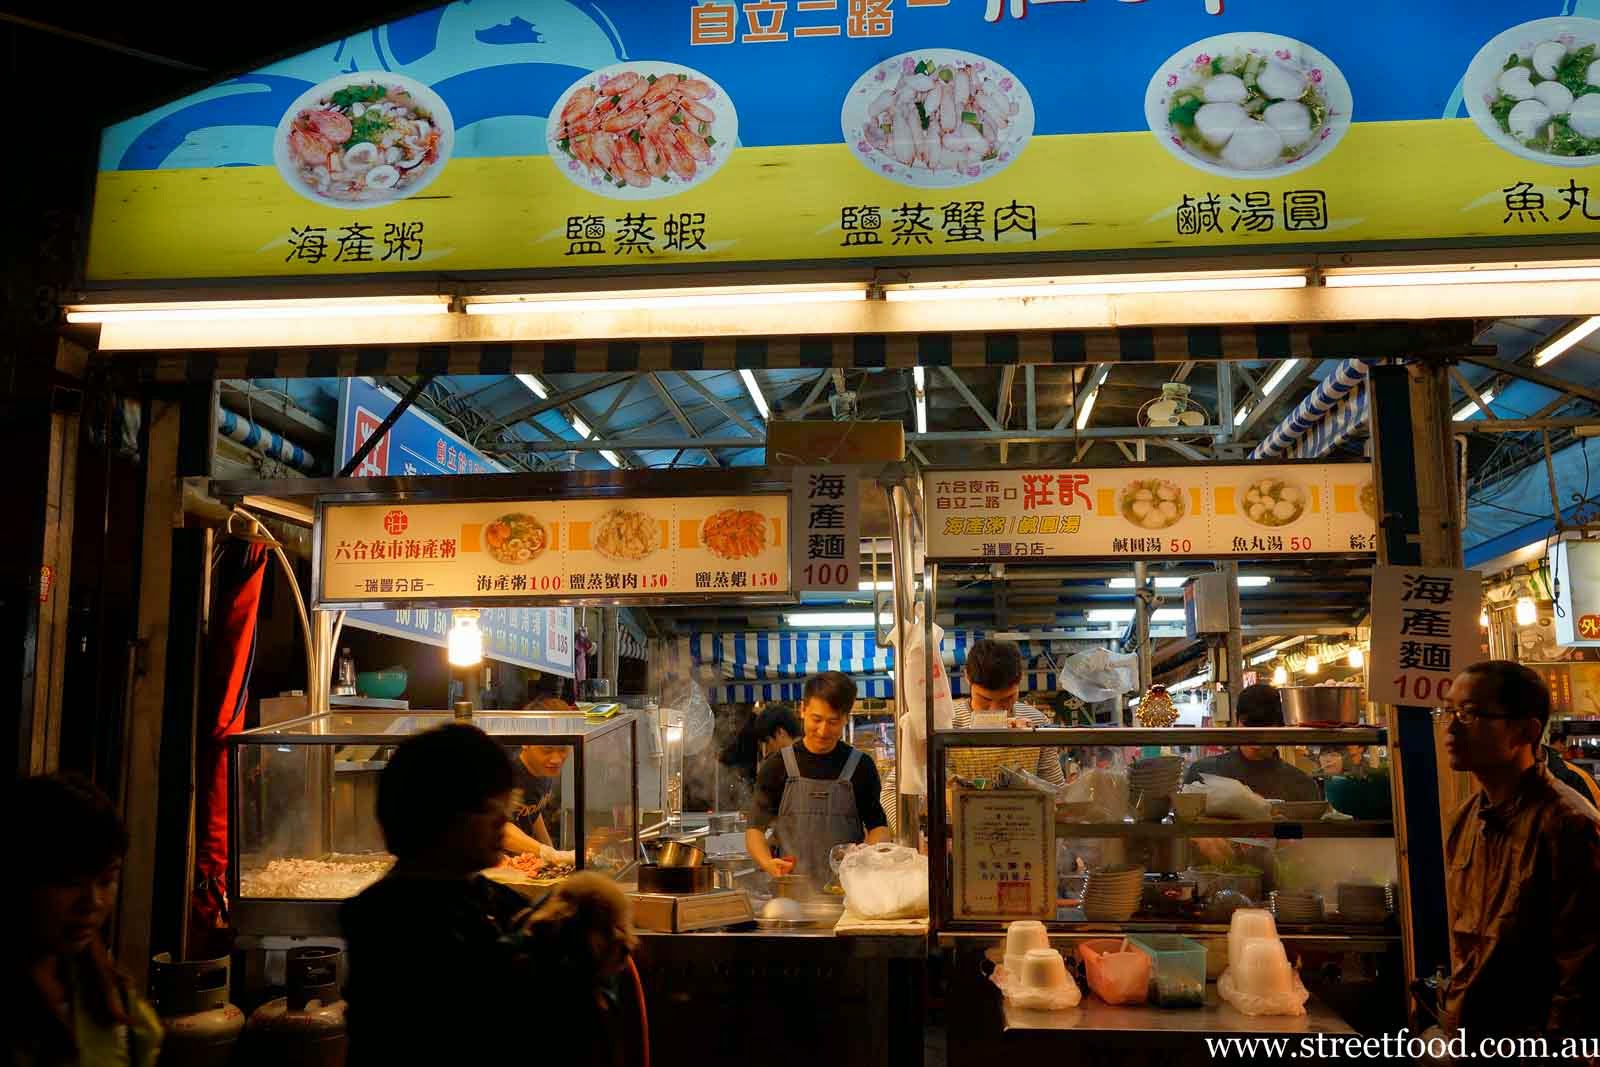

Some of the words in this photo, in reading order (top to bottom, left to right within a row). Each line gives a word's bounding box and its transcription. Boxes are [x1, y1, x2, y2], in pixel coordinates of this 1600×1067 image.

[690, 0, 949, 46] 自立二路
[1176, 190, 1328, 234] 鹹湯圓
[1503, 179, 1600, 223] 魚丸
[285, 221, 424, 265] 海產粥
[565, 212, 708, 256] 鹽蒸蝦
[841, 200, 1038, 247] 鹽蒸蟹肉
[936, 480, 1000, 494] 六合夜市
[936, 496, 1000, 510] 自立二路
[1022, 474, 1093, 511] 莊記
[808, 473, 846, 560] 海產麵
[335, 539, 457, 561] 六合夜市海產粥
[1170, 538, 1193, 553] 50
[1231, 535, 1283, 552] 魚丸湯
[1290, 537, 1312, 551] 50
[803, 564, 849, 585] 100
[1400, 573, 1454, 673] 海產麵
[1581, 618, 1600, 636] 外
